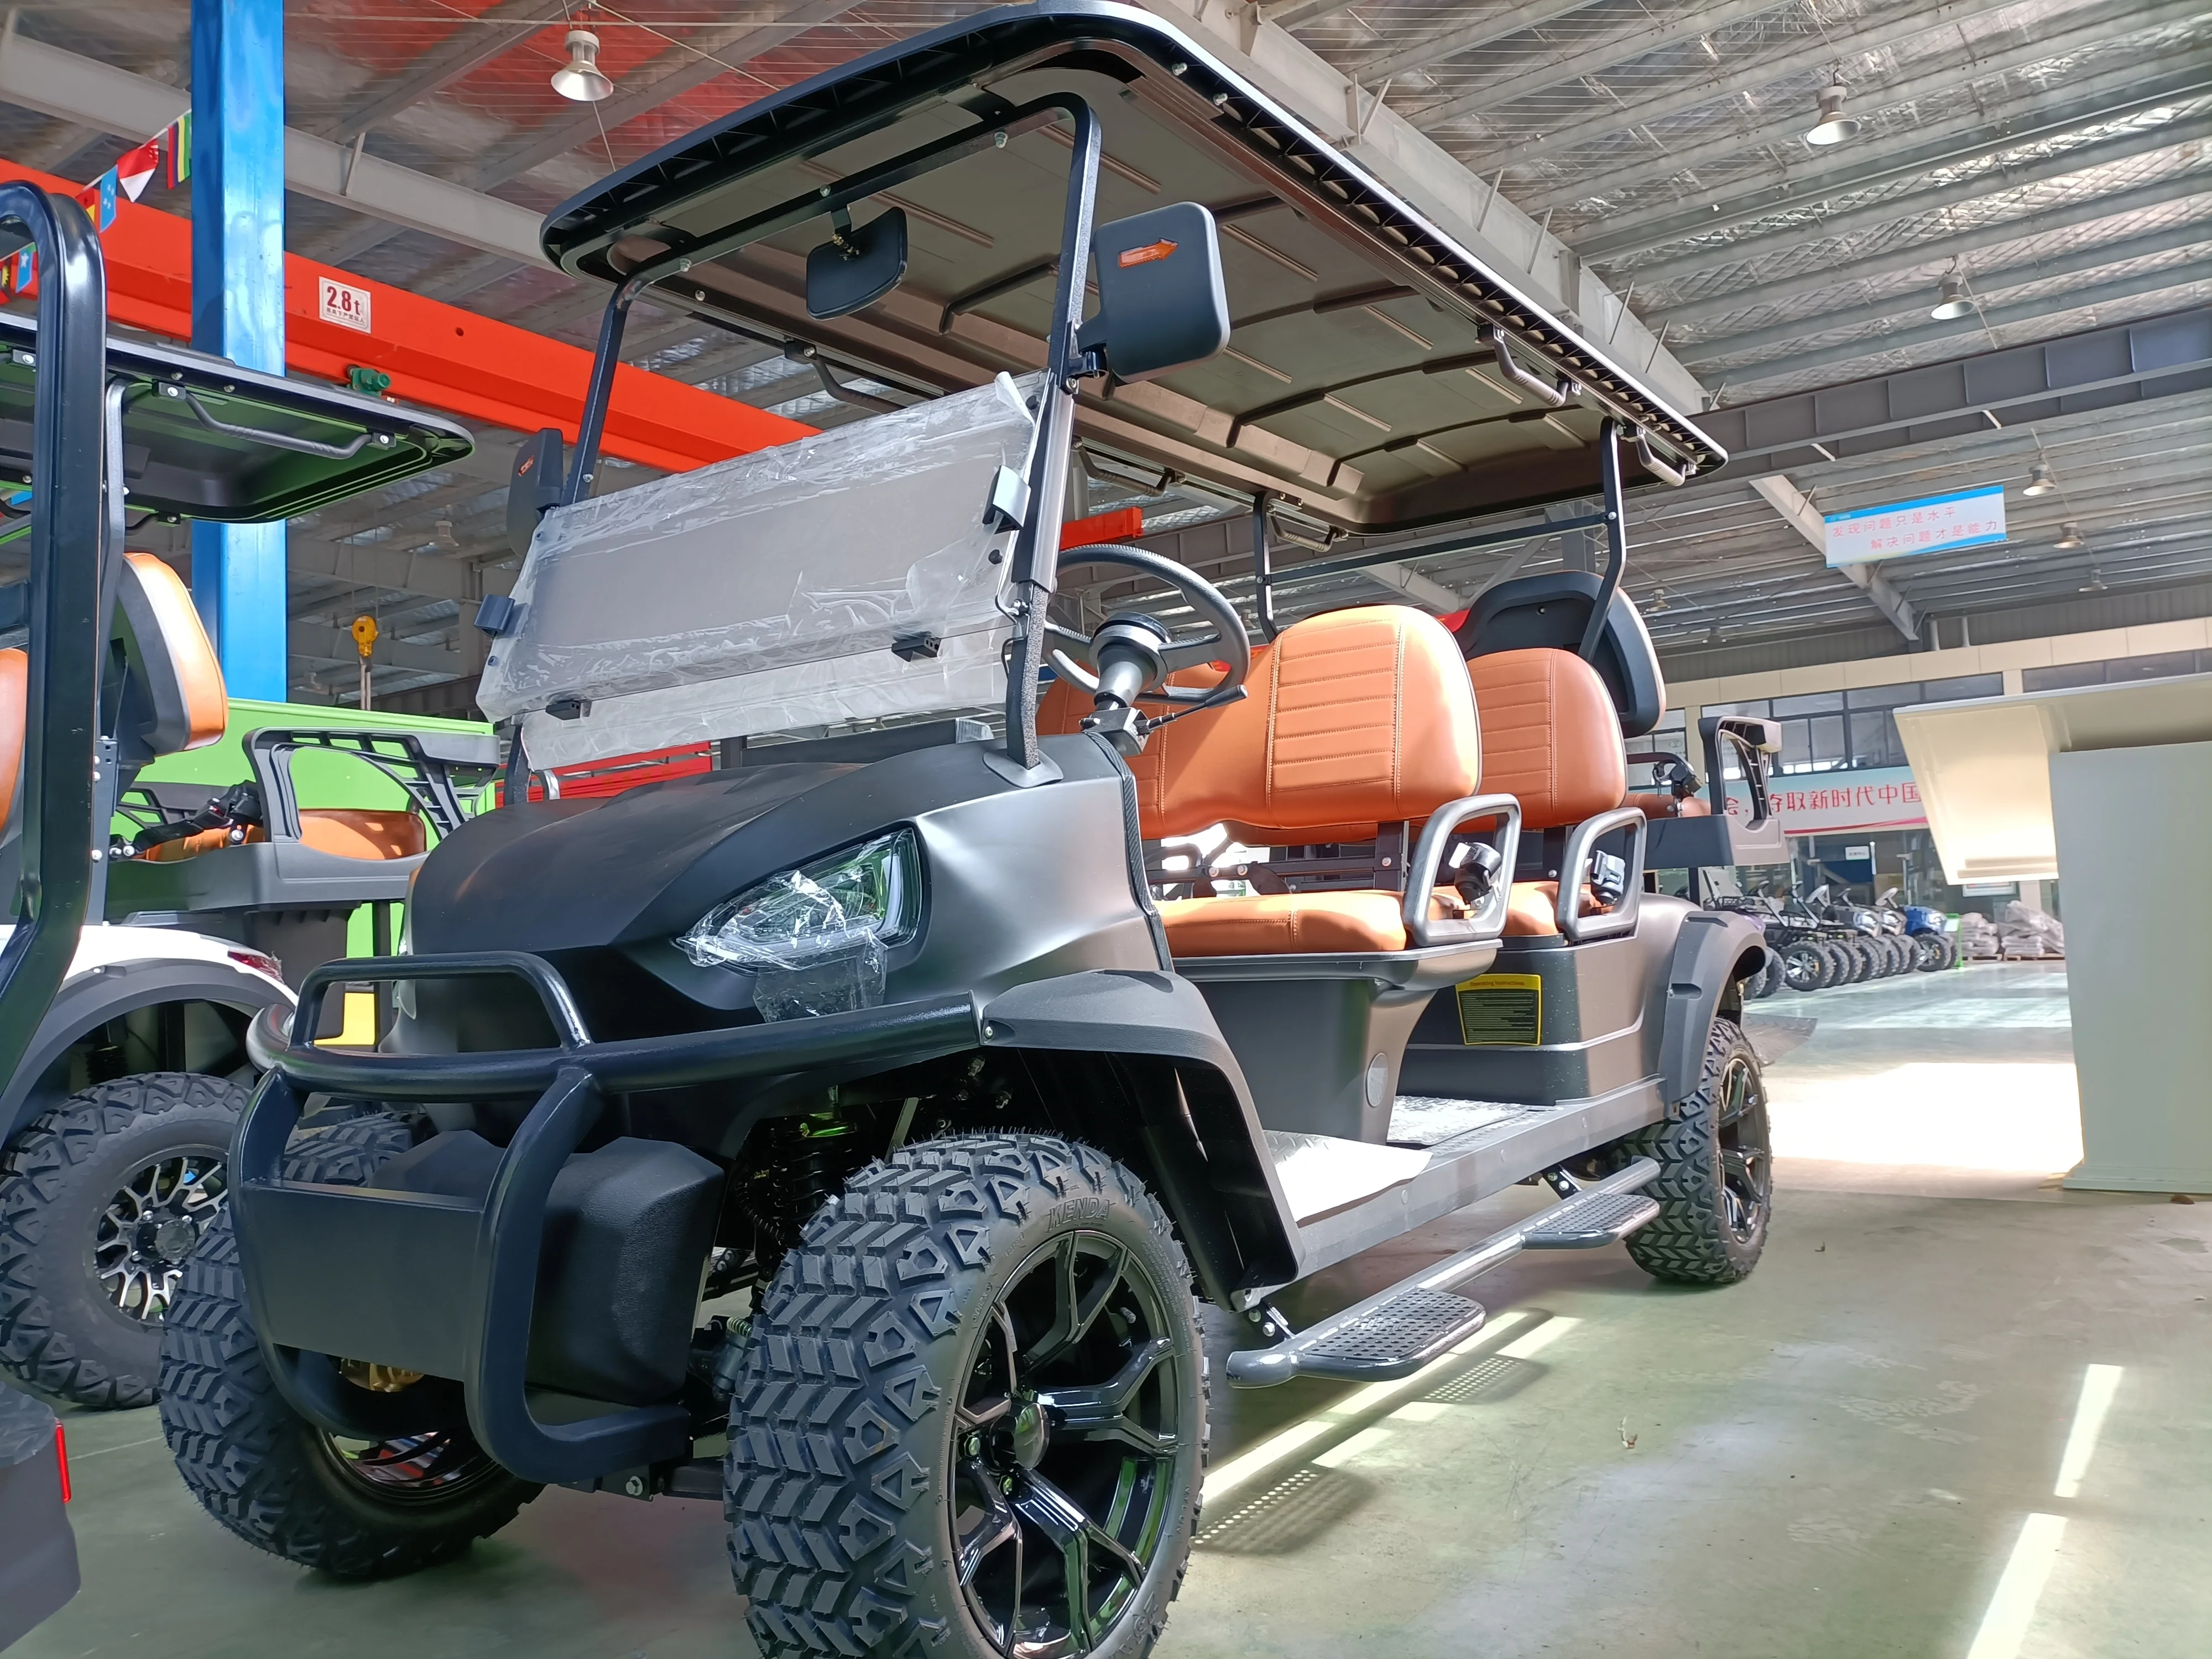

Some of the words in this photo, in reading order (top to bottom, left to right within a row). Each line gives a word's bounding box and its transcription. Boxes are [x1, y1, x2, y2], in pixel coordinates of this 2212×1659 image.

[1833, 506, 1956, 538] 发现问题只是水平
[1870, 519, 1997, 550] 解决问题才是能力
[1047, 1197, 1111, 1232] KENDA
